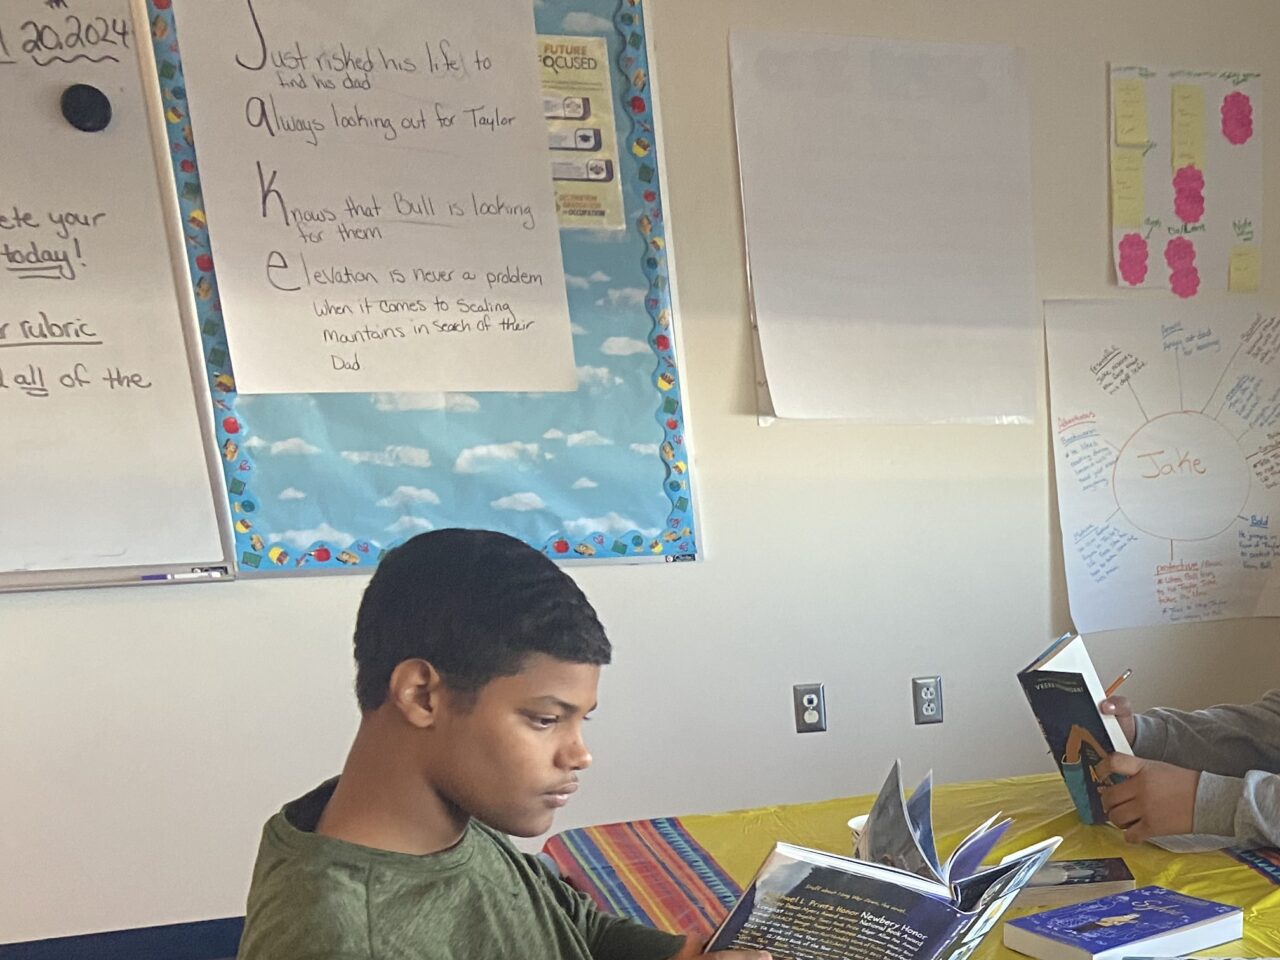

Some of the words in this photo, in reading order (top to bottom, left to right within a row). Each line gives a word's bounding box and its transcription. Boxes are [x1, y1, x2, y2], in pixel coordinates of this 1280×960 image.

[378, 47, 416, 73] his
[474, 50, 492, 70] to
[544, 43, 587, 54] FUTURE
[314, 75, 336, 90] his
[342, 72, 371, 90] dad
[331, 103, 397, 140] looking
[401, 109, 425, 130] out
[435, 102, 455, 127] for
[464, 106, 517, 131] Taylor
[344, 194, 381, 217] that
[393, 192, 435, 217] Bull
[449, 202, 464, 216] is
[472, 193, 535, 230] looking
[48, 212, 106, 239] your
[300, 226, 324, 243] for
[338, 223, 382, 242] them
[389, 270, 406, 283] is
[413, 268, 455, 283] never
[462, 272, 476, 280] a
[487, 266, 543, 288] problem
[360, 298, 373, 314] it
[434, 297, 449, 311] to
[20, 312, 97, 338] rubric
[414, 319, 430, 335] in
[477, 317, 491, 331] of
[499, 317, 535, 332] their
[331, 353, 360, 370] Dad
[14, 364, 45, 387] all
[60, 363, 90, 387] of
[103, 367, 152, 389] the
[1137, 448, 1207, 480] Jake
[1250, 514, 1269, 526] Bold
[808, 899, 834, 911] Printz
[836, 906, 859, 916] Honor
[860, 911, 901, 930] Newbery
[901, 924, 928, 940] Honor
[859, 919, 886, 931] National
[886, 927, 901, 937] Book
[901, 934, 924, 947] Award
